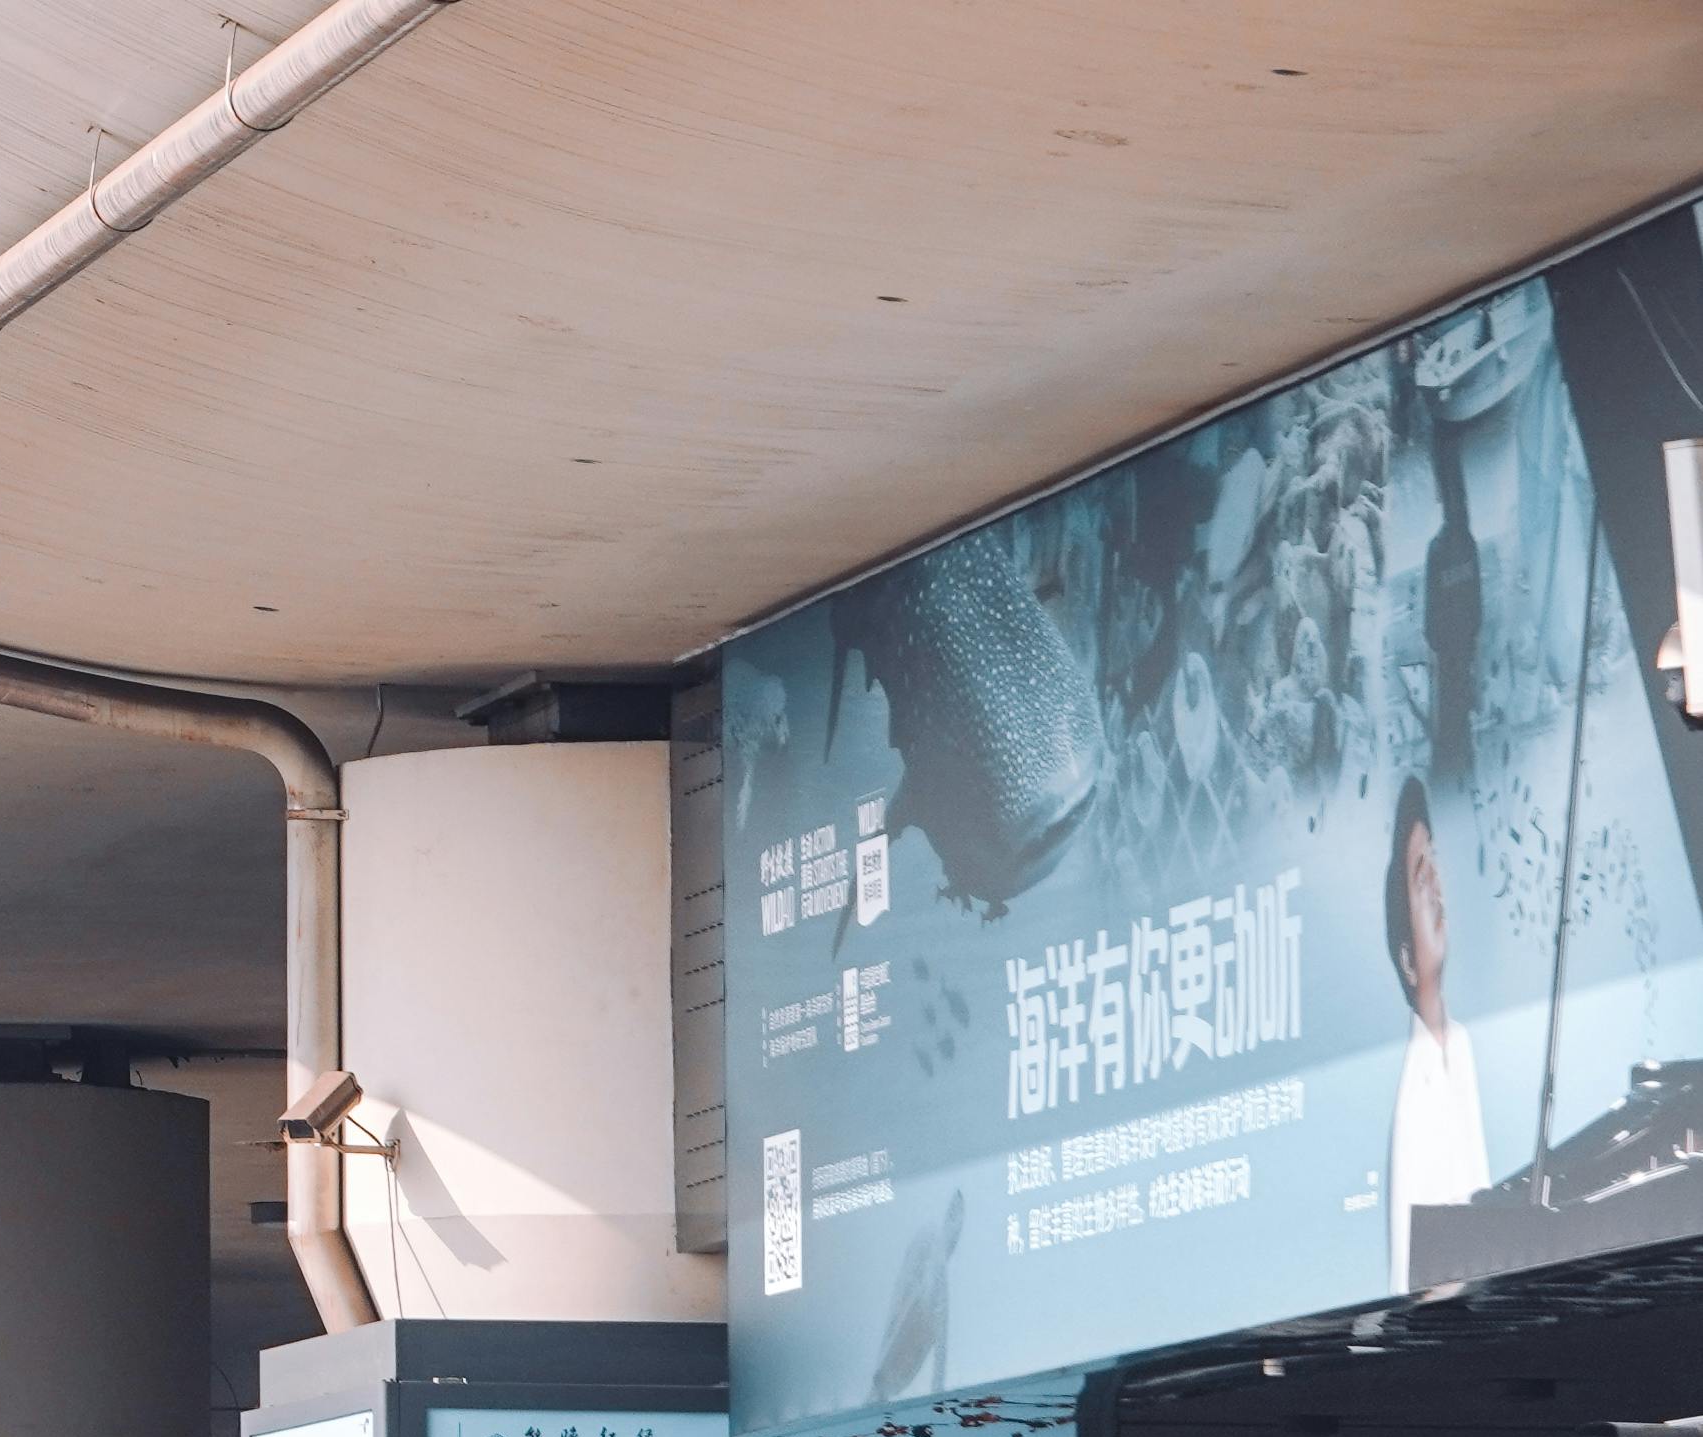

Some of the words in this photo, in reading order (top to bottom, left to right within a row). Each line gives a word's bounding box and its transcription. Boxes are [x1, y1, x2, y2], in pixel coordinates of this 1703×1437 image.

[1006, 867, 1304, 1119] 海洋有你更动听
